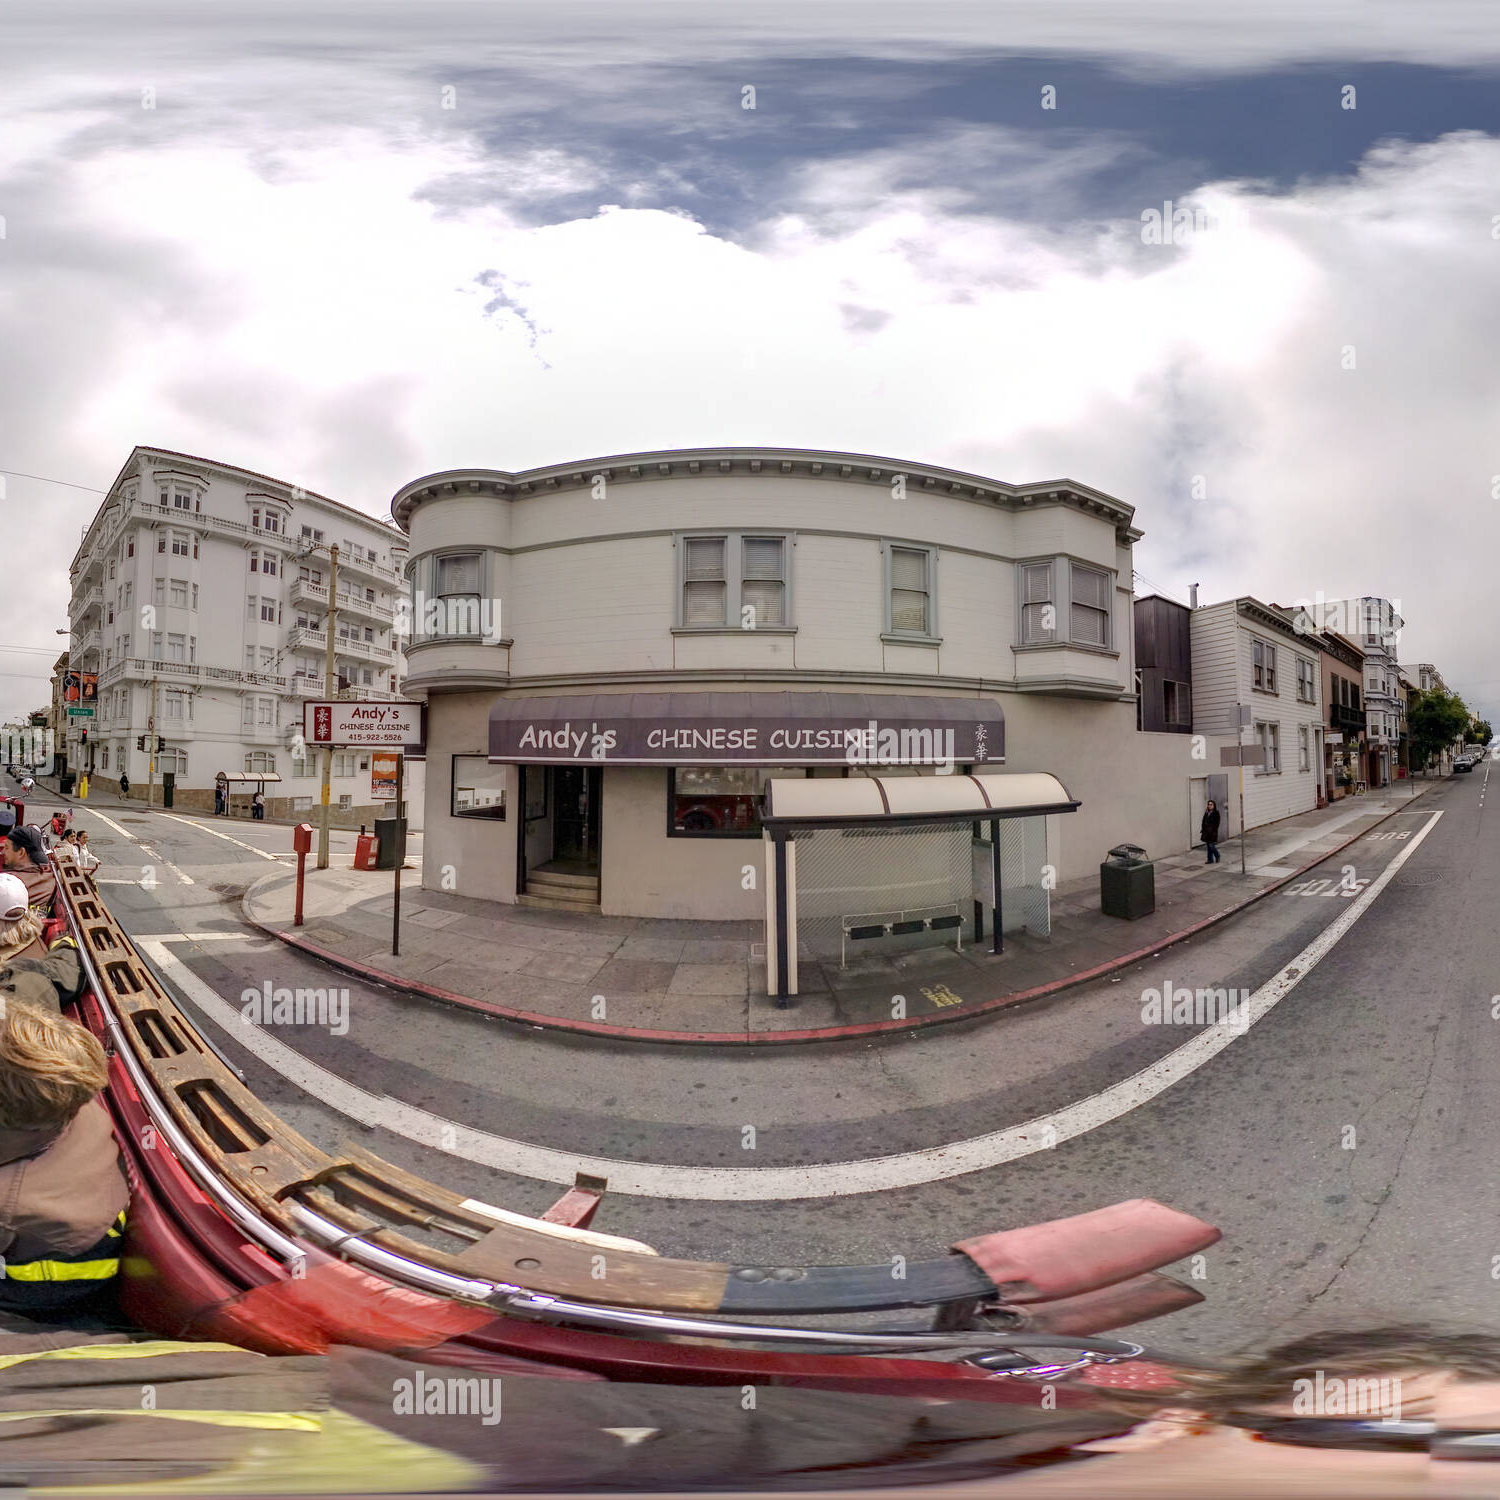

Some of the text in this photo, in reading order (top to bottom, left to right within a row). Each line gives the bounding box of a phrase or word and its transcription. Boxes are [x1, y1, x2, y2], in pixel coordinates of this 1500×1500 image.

[352, 707, 399, 722] Andy's
[340, 723, 410, 731] CHINESE CUISINE
[518, 722, 875, 758] Andy's CHINESE CUISINE
[1366, 831, 1412, 841] BUS
[1283, 878, 1371, 897] STOP
